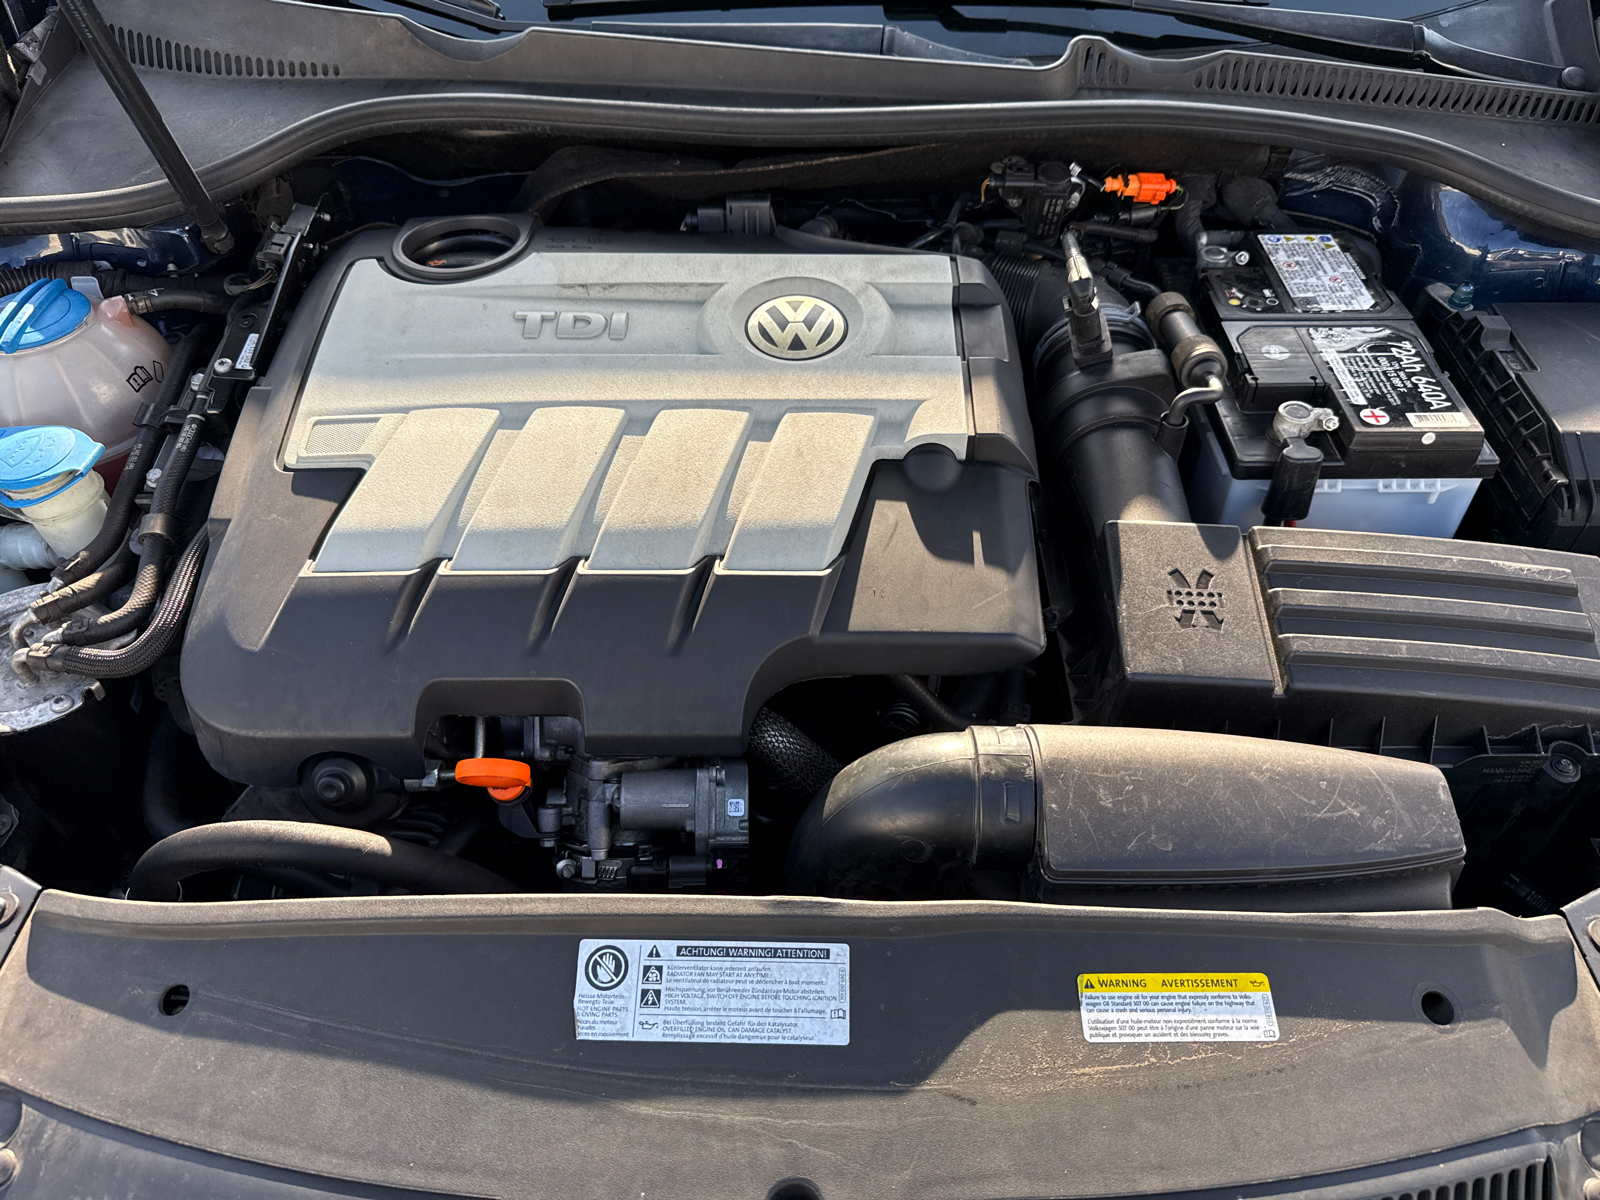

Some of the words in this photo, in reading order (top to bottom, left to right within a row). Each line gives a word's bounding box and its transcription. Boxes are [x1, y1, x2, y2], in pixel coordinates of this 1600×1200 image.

[514, 311, 629, 340] TDI
[1387, 341, 1425, 372] 72Ah
[1411, 376, 1452, 410] 640A
[680, 947, 726, 956] ACHTUNG!
[728, 948, 774, 957] WARNING!
[776, 950, 827, 958] ATTENTION!
[1099, 979, 1147, 988] WARNING
[1161, 979, 1238, 988] AVERTISSEMENT
